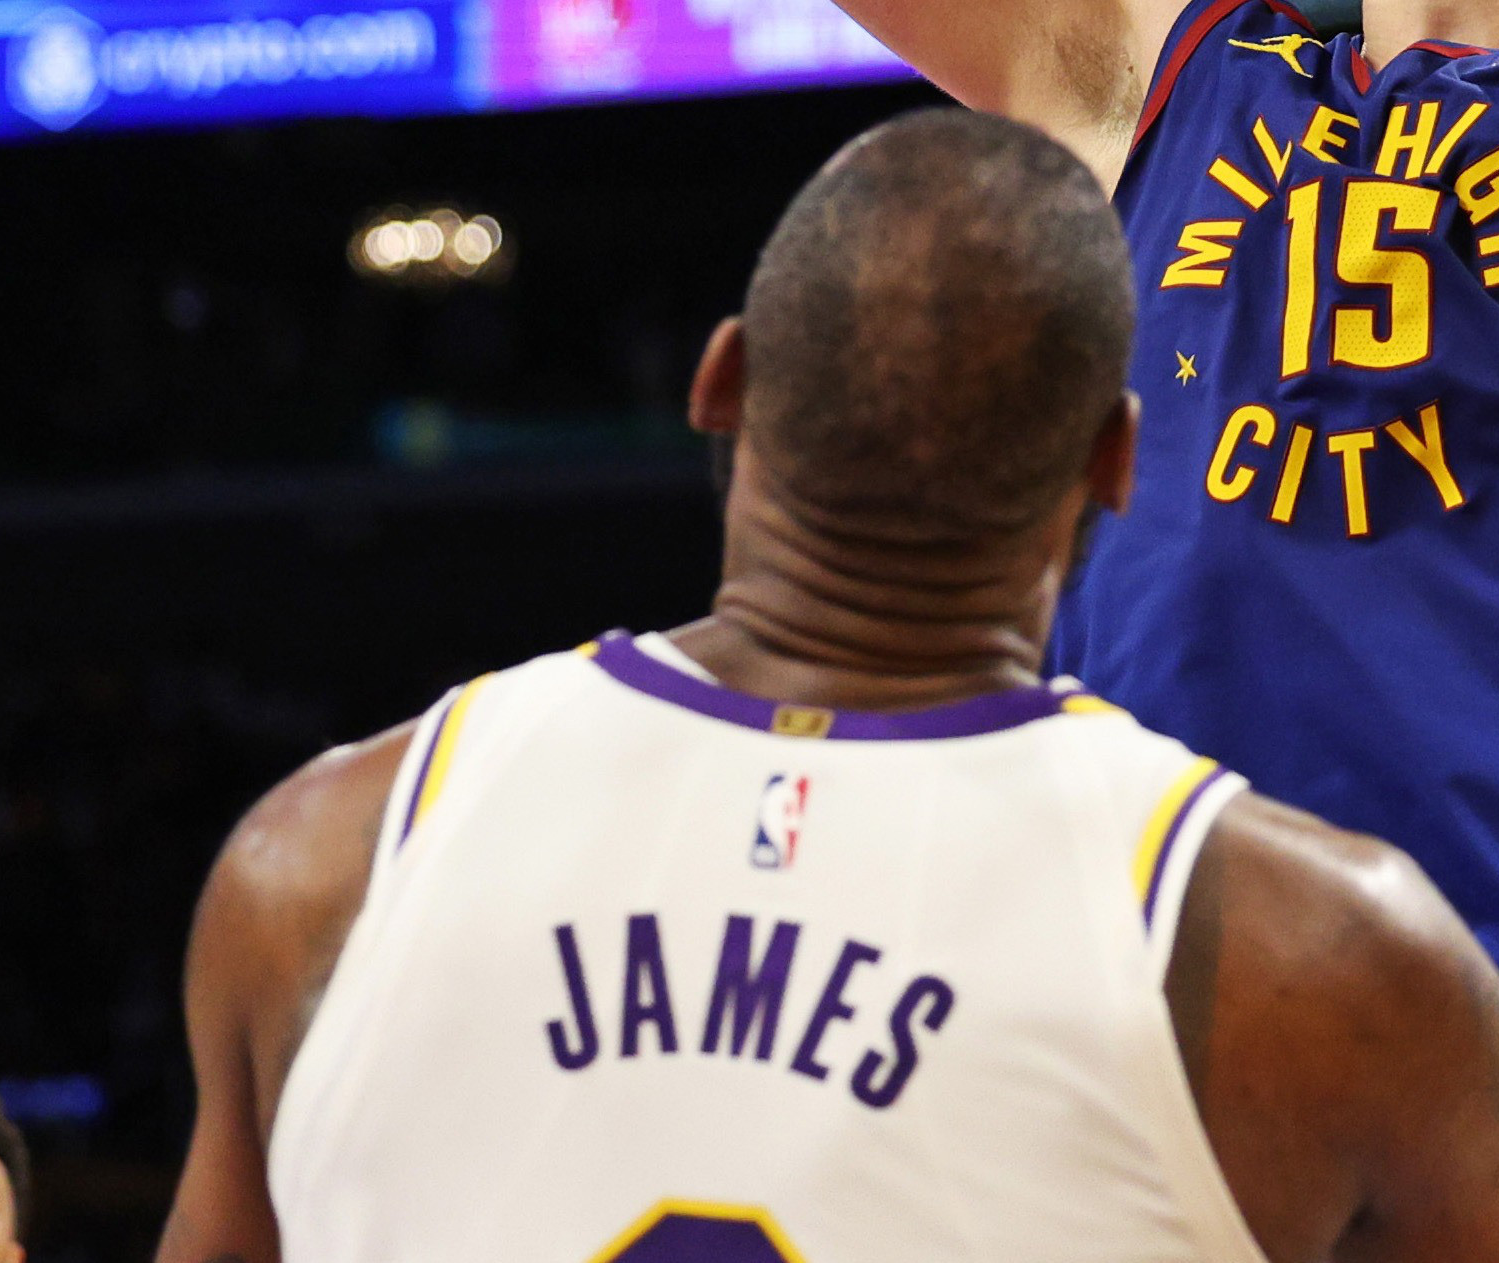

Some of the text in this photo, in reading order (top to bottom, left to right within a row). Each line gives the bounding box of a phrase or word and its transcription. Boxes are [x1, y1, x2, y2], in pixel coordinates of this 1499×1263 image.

[102, 7, 436, 99] crypto.com
[1159, 103, 1362, 292] MILE
[1279, 173, 1443, 382] 15
[1205, 397, 1466, 539] CITY
[543, 912, 957, 1112] JAMES
